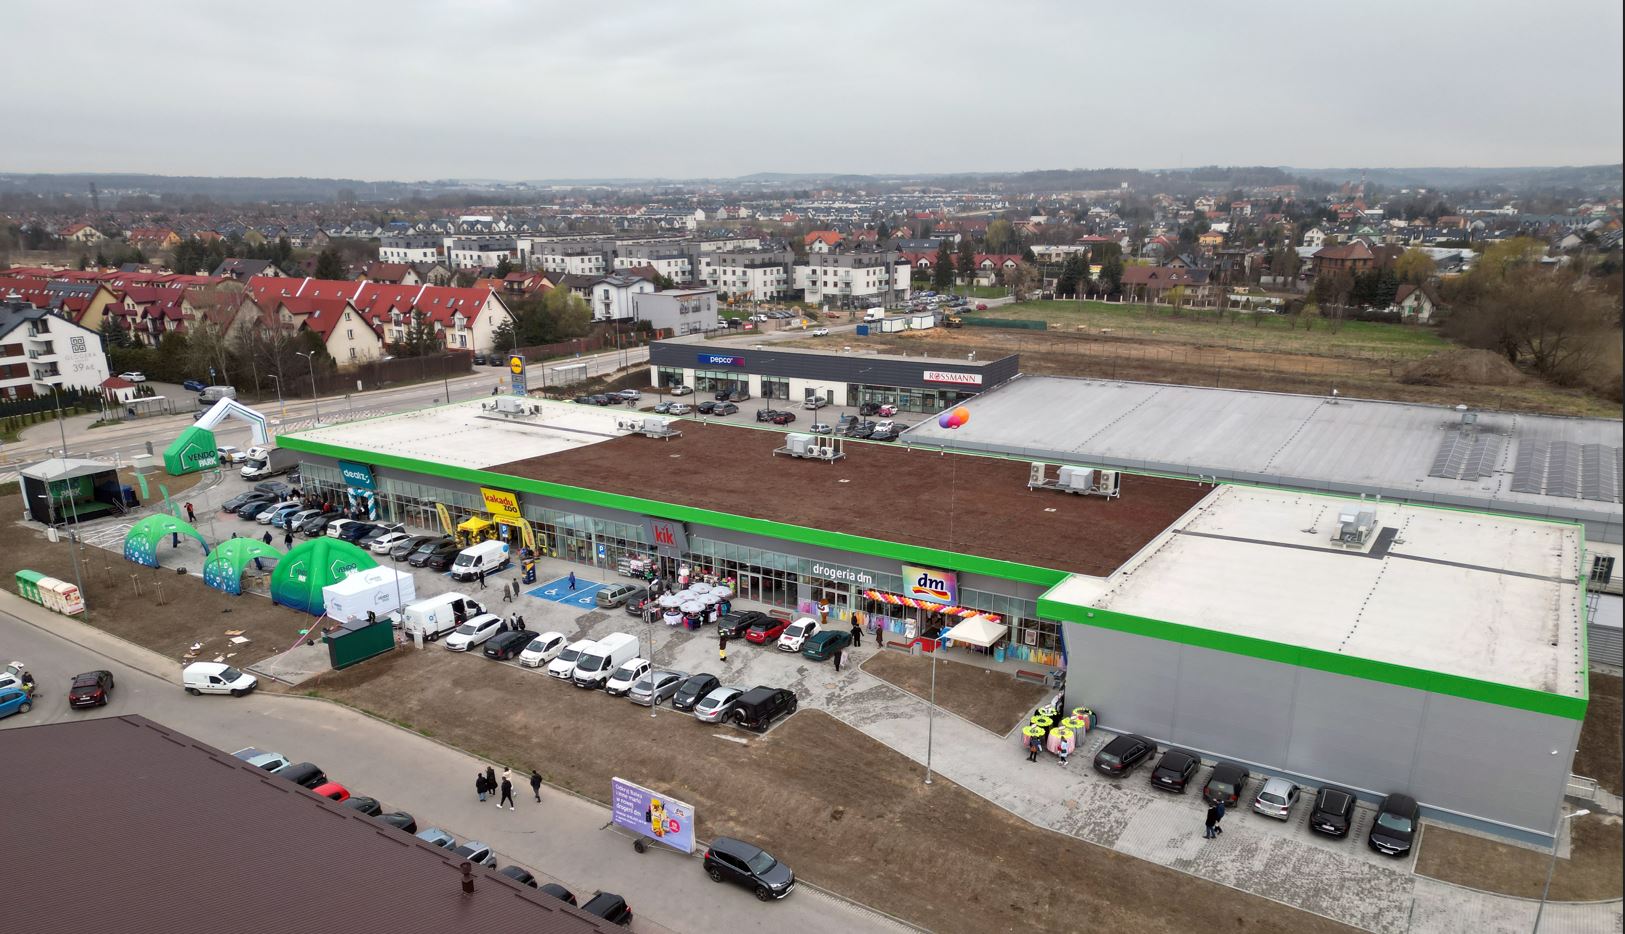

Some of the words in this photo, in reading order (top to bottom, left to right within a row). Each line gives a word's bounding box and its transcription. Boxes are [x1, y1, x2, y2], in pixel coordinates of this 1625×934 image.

[710, 356, 732, 364] pepco
[929, 372, 976, 383] ROSSMANN
[188, 450, 216, 462] VENDO
[198, 457, 217, 468] PARK
[484, 493, 514, 506] kakadu
[813, 563, 856, 580] drogeria
[857, 571, 872, 584] dm
[918, 573, 944, 590] dm
